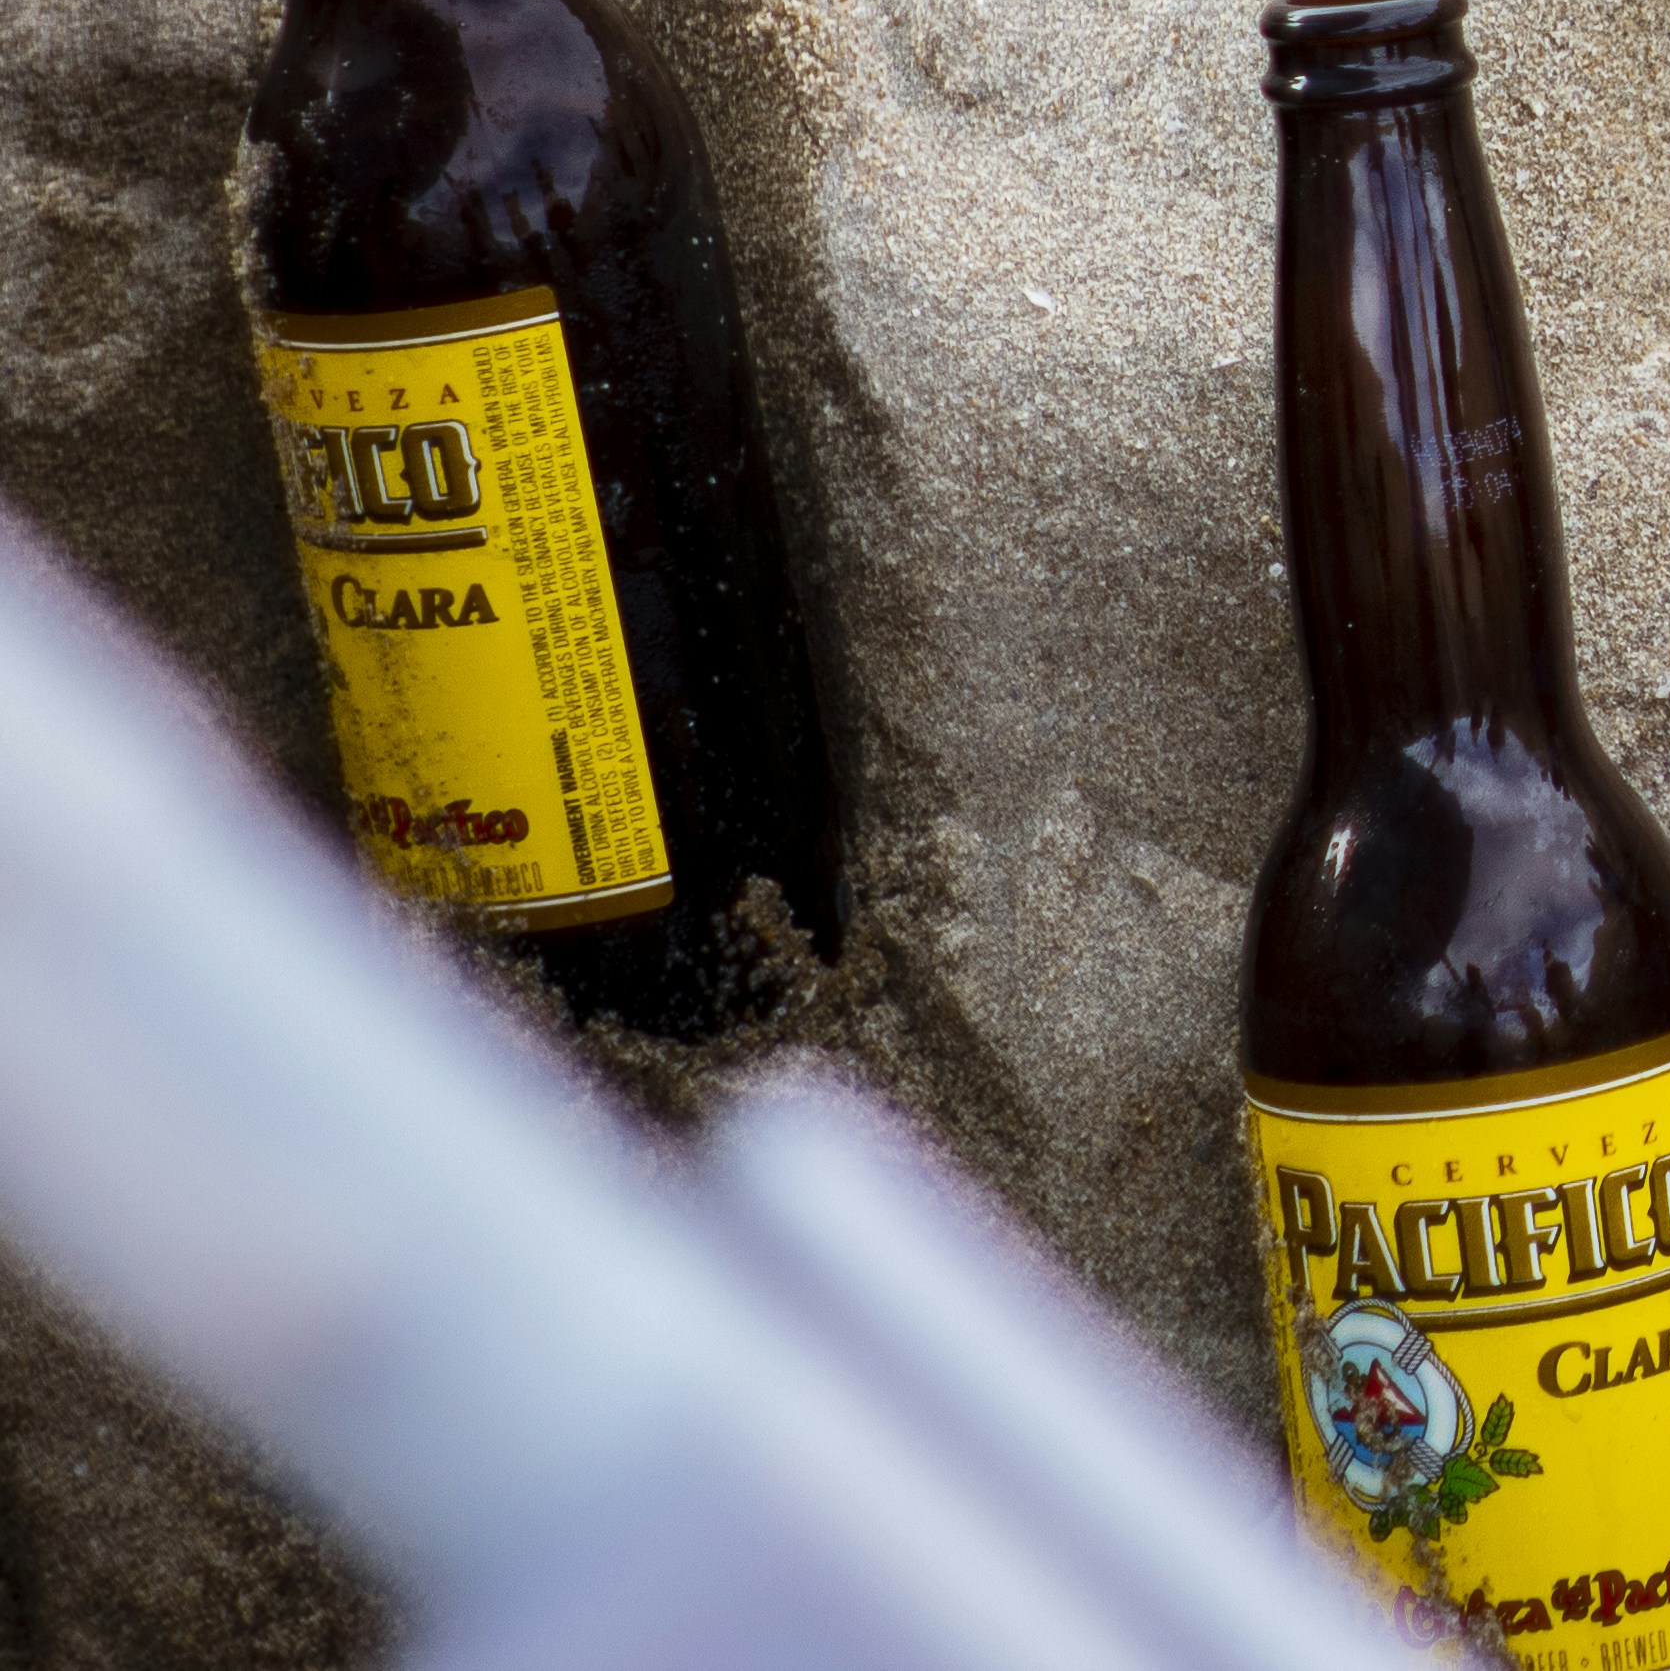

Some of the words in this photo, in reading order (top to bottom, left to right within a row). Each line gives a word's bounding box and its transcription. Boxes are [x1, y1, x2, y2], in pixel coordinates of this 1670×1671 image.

[471, 346, 498, 398] SHOULD
[492, 342, 512, 361] OF
[512, 337, 535, 377] YOUR
[496, 364, 518, 395] RISK
[482, 400, 509, 452] WOMEN
[504, 399, 524, 425] THE
[521, 380, 547, 438] IMPAIRS
[510, 428, 528, 446] OF
[547, 407, 572, 457] HEALTH
[514, 450, 542, 511] BECAUSE
[534, 442, 565, 524] BEVERAGES
[557, 460, 582, 503] CAUSE
[567, 504, 588, 533] MAY
[506, 515, 534, 576] SURGEON
[527, 514, 559, 595] PREGNANCY
[573, 534, 596, 563] AND
[550, 528, 583, 608] ALCOHOLIC
[331, 573, 500, 631] CLARA
[518, 581, 539, 602] THE
[524, 606, 544, 624] TO
[543, 597, 570, 649] DURING
[567, 612, 587, 631] OF
[528, 626, 560, 701] ACCORDING
[596, 645, 622, 702] OPERATE
[555, 651, 585, 729] BEVERAGES
[573, 634, 608, 738] CONSUMPTION
[607, 703, 627, 724] OR
[594, 741, 616, 761] (2)
[611, 724, 633, 753] CAR
[618, 753, 634, 765] A
[549, 726, 577, 794] WARNING:
[571, 731, 601, 807] ALCOHOLIC
[620, 765, 642, 803] DRIVE
[587, 809, 611, 851] DRINK
[627, 804, 646, 823] TO
[563, 796, 596, 886] GOVERNMENT
[613, 836, 637, 877] BIRTH
[631, 825, 657, 872] ABILITY
[595, 854, 617, 882] NOT
[1600, 1630, 1668, 1671] BREWED
